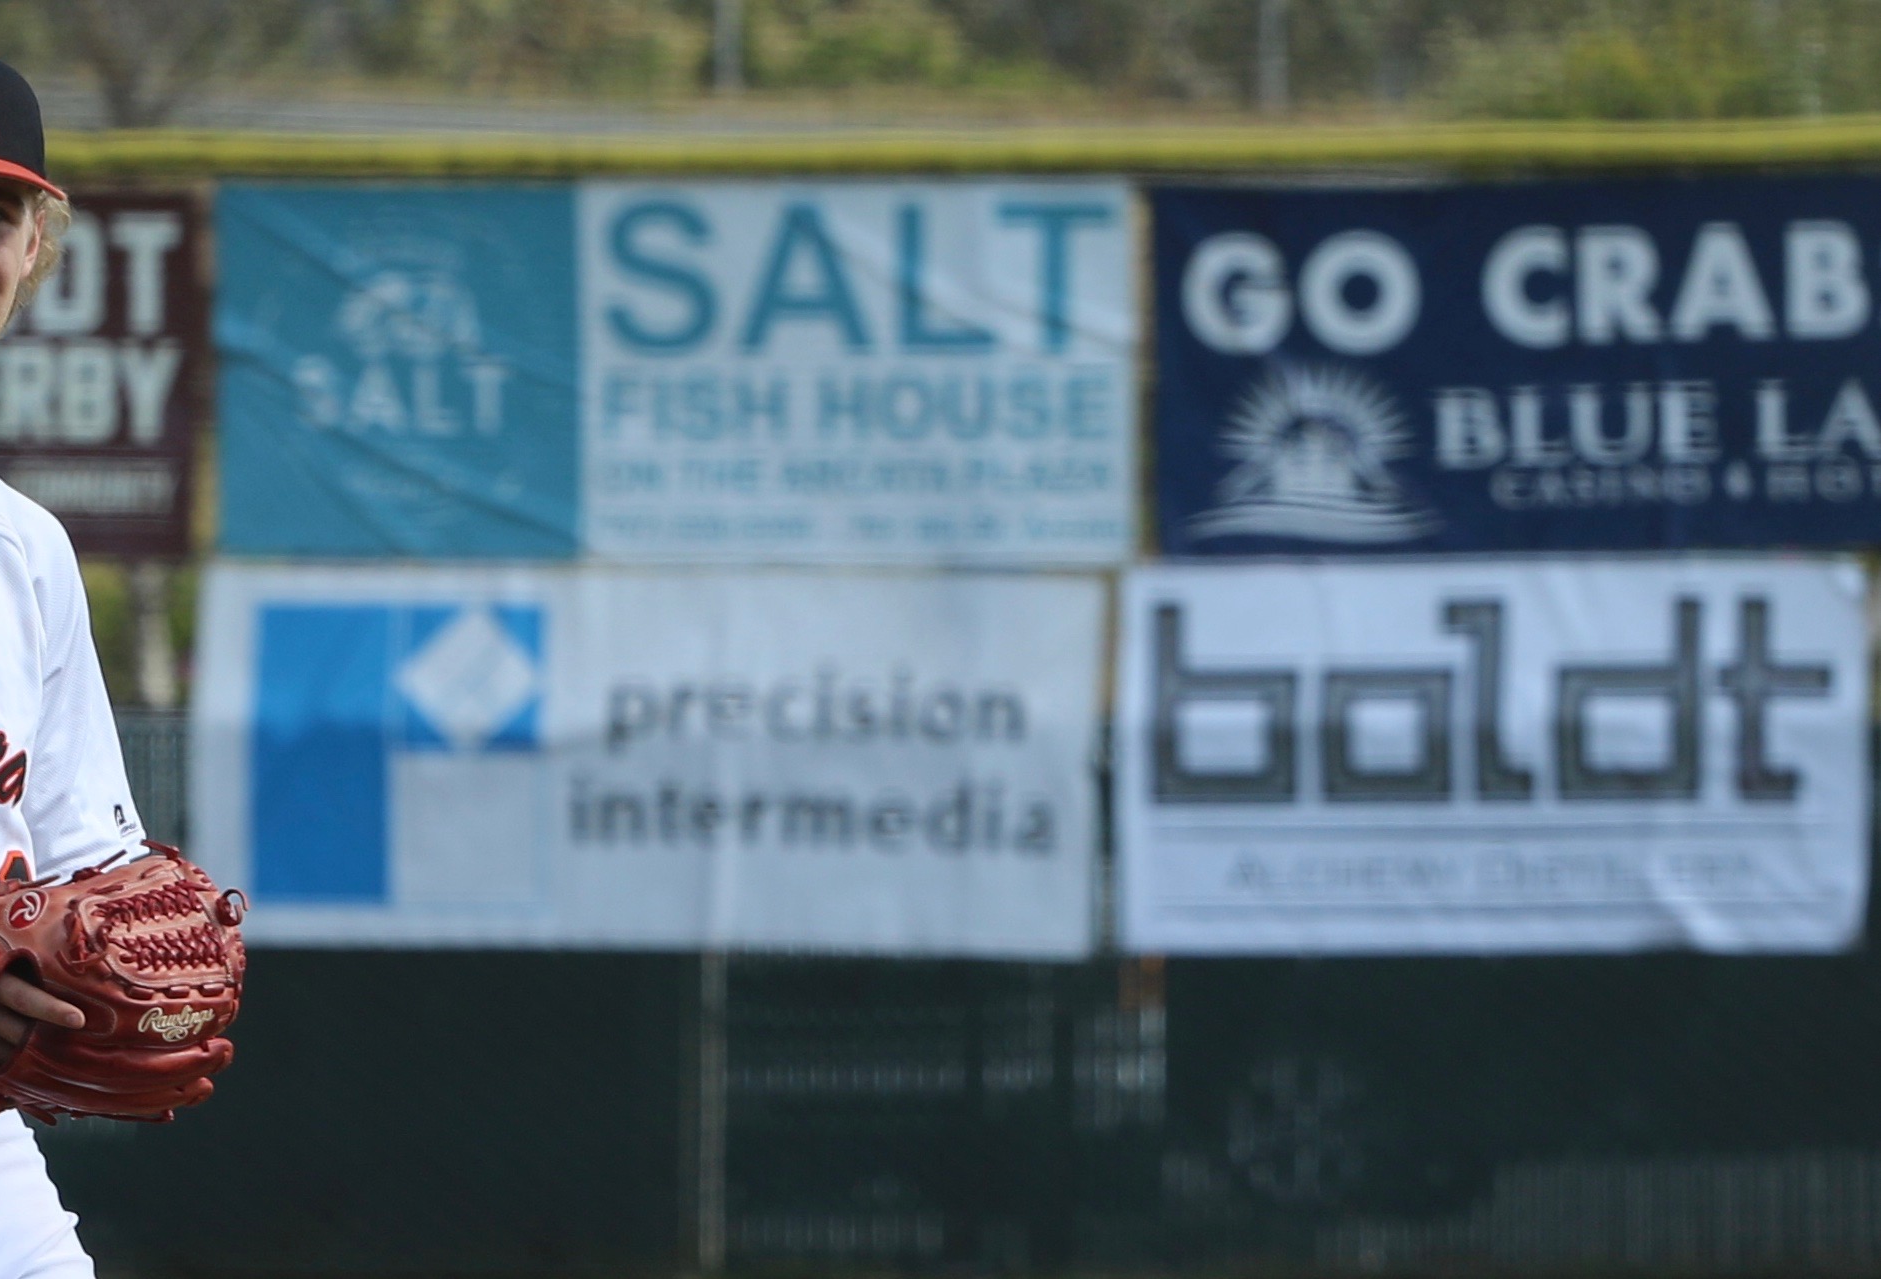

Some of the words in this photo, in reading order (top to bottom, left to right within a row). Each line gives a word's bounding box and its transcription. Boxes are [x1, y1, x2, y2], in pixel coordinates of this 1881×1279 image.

[603, 202, 1111, 358] SALT
[1180, 230, 1421, 354] GO
[1481, 220, 1873, 349] CRAB
[291, 353, 509, 438] SALT
[603, 371, 789, 441] FISH
[816, 369, 1109, 441] HOUSE
[1433, 372, 1721, 469] BLUE
[605, 663, 1027, 745] precision
[1153, 597, 1831, 804] boldt
[568, 775, 1059, 856] intermedia
[137, 1004, 216, 1043] Rawlings
